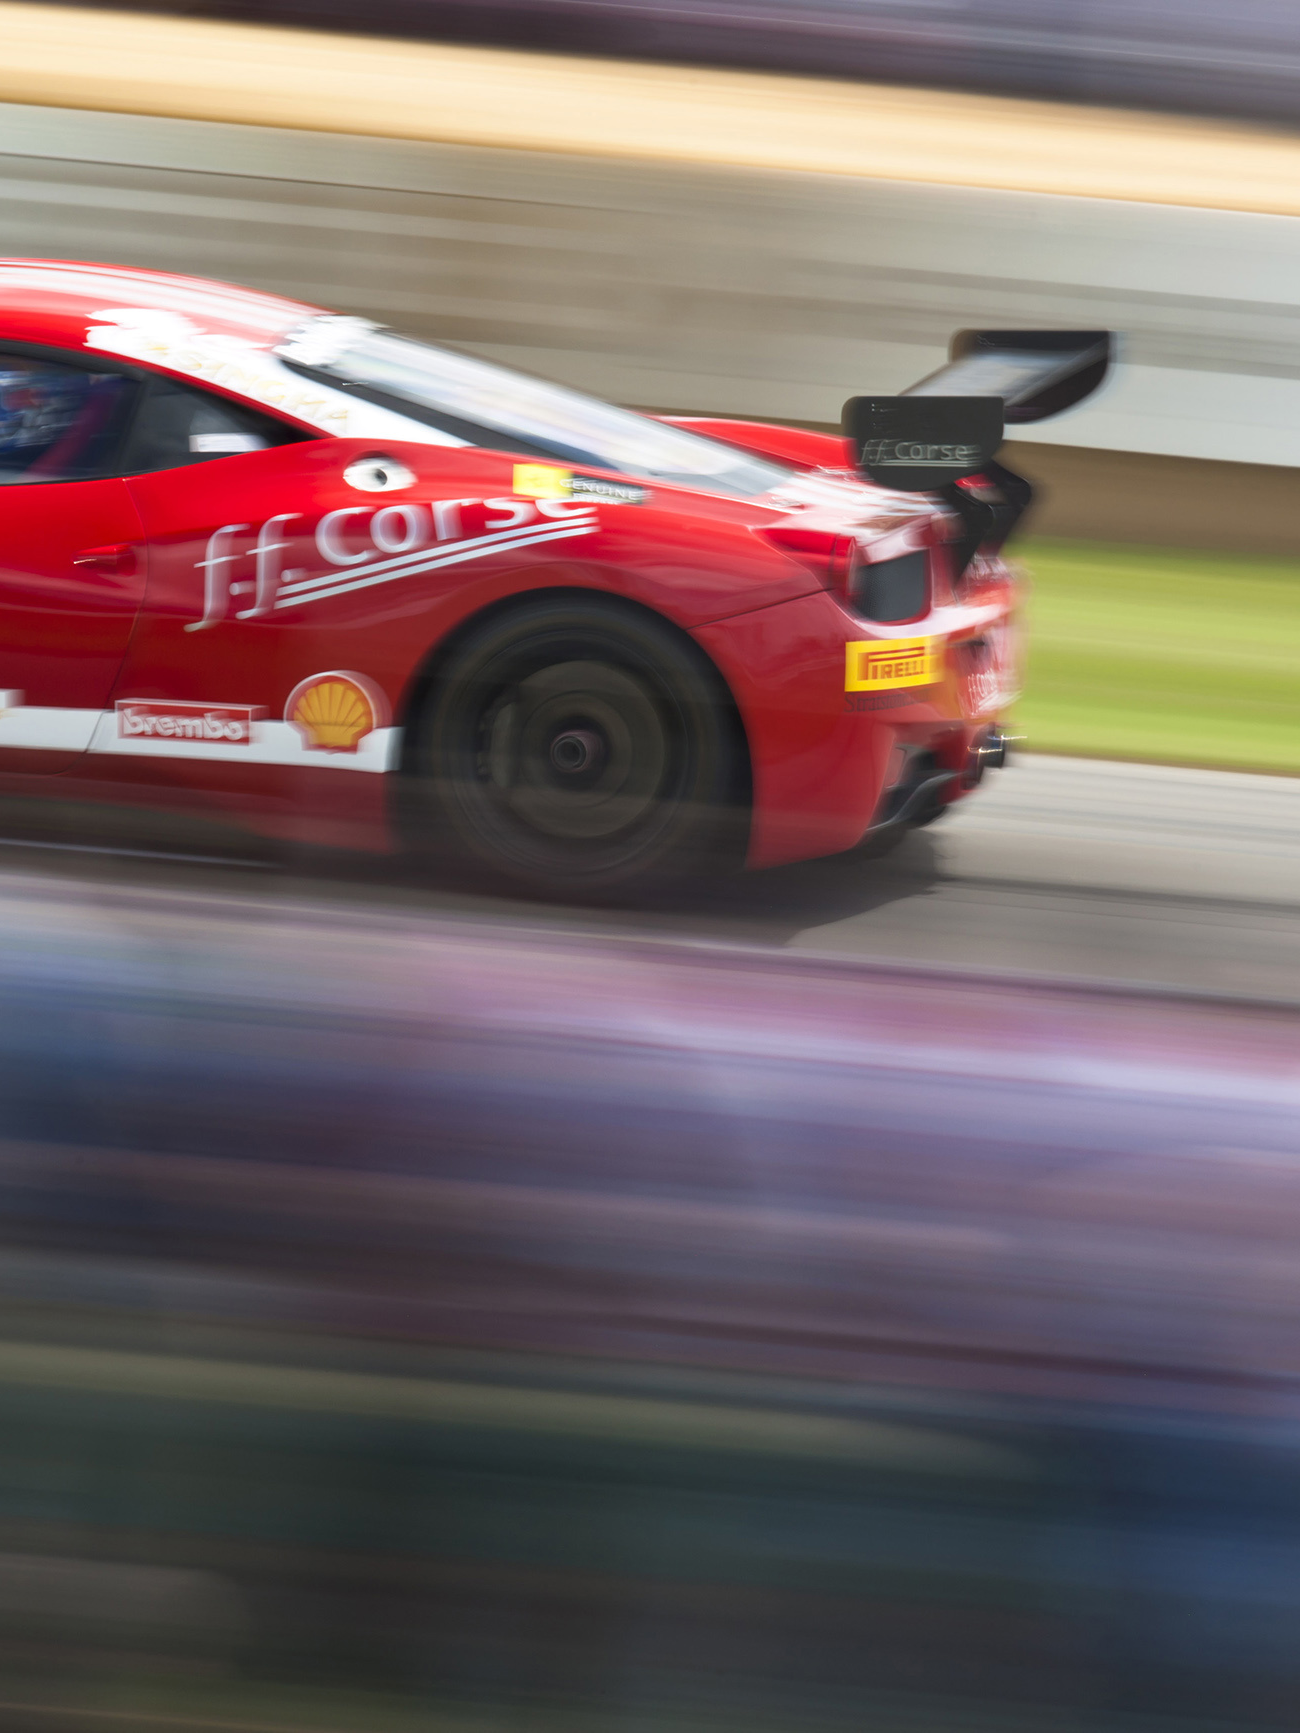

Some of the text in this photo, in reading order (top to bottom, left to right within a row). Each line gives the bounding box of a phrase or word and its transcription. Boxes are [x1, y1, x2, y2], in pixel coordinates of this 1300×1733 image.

[559, 478, 648, 500] GENUINE
[857, 645, 927, 681] PIRELLI
[122, 707, 246, 741] brembo
